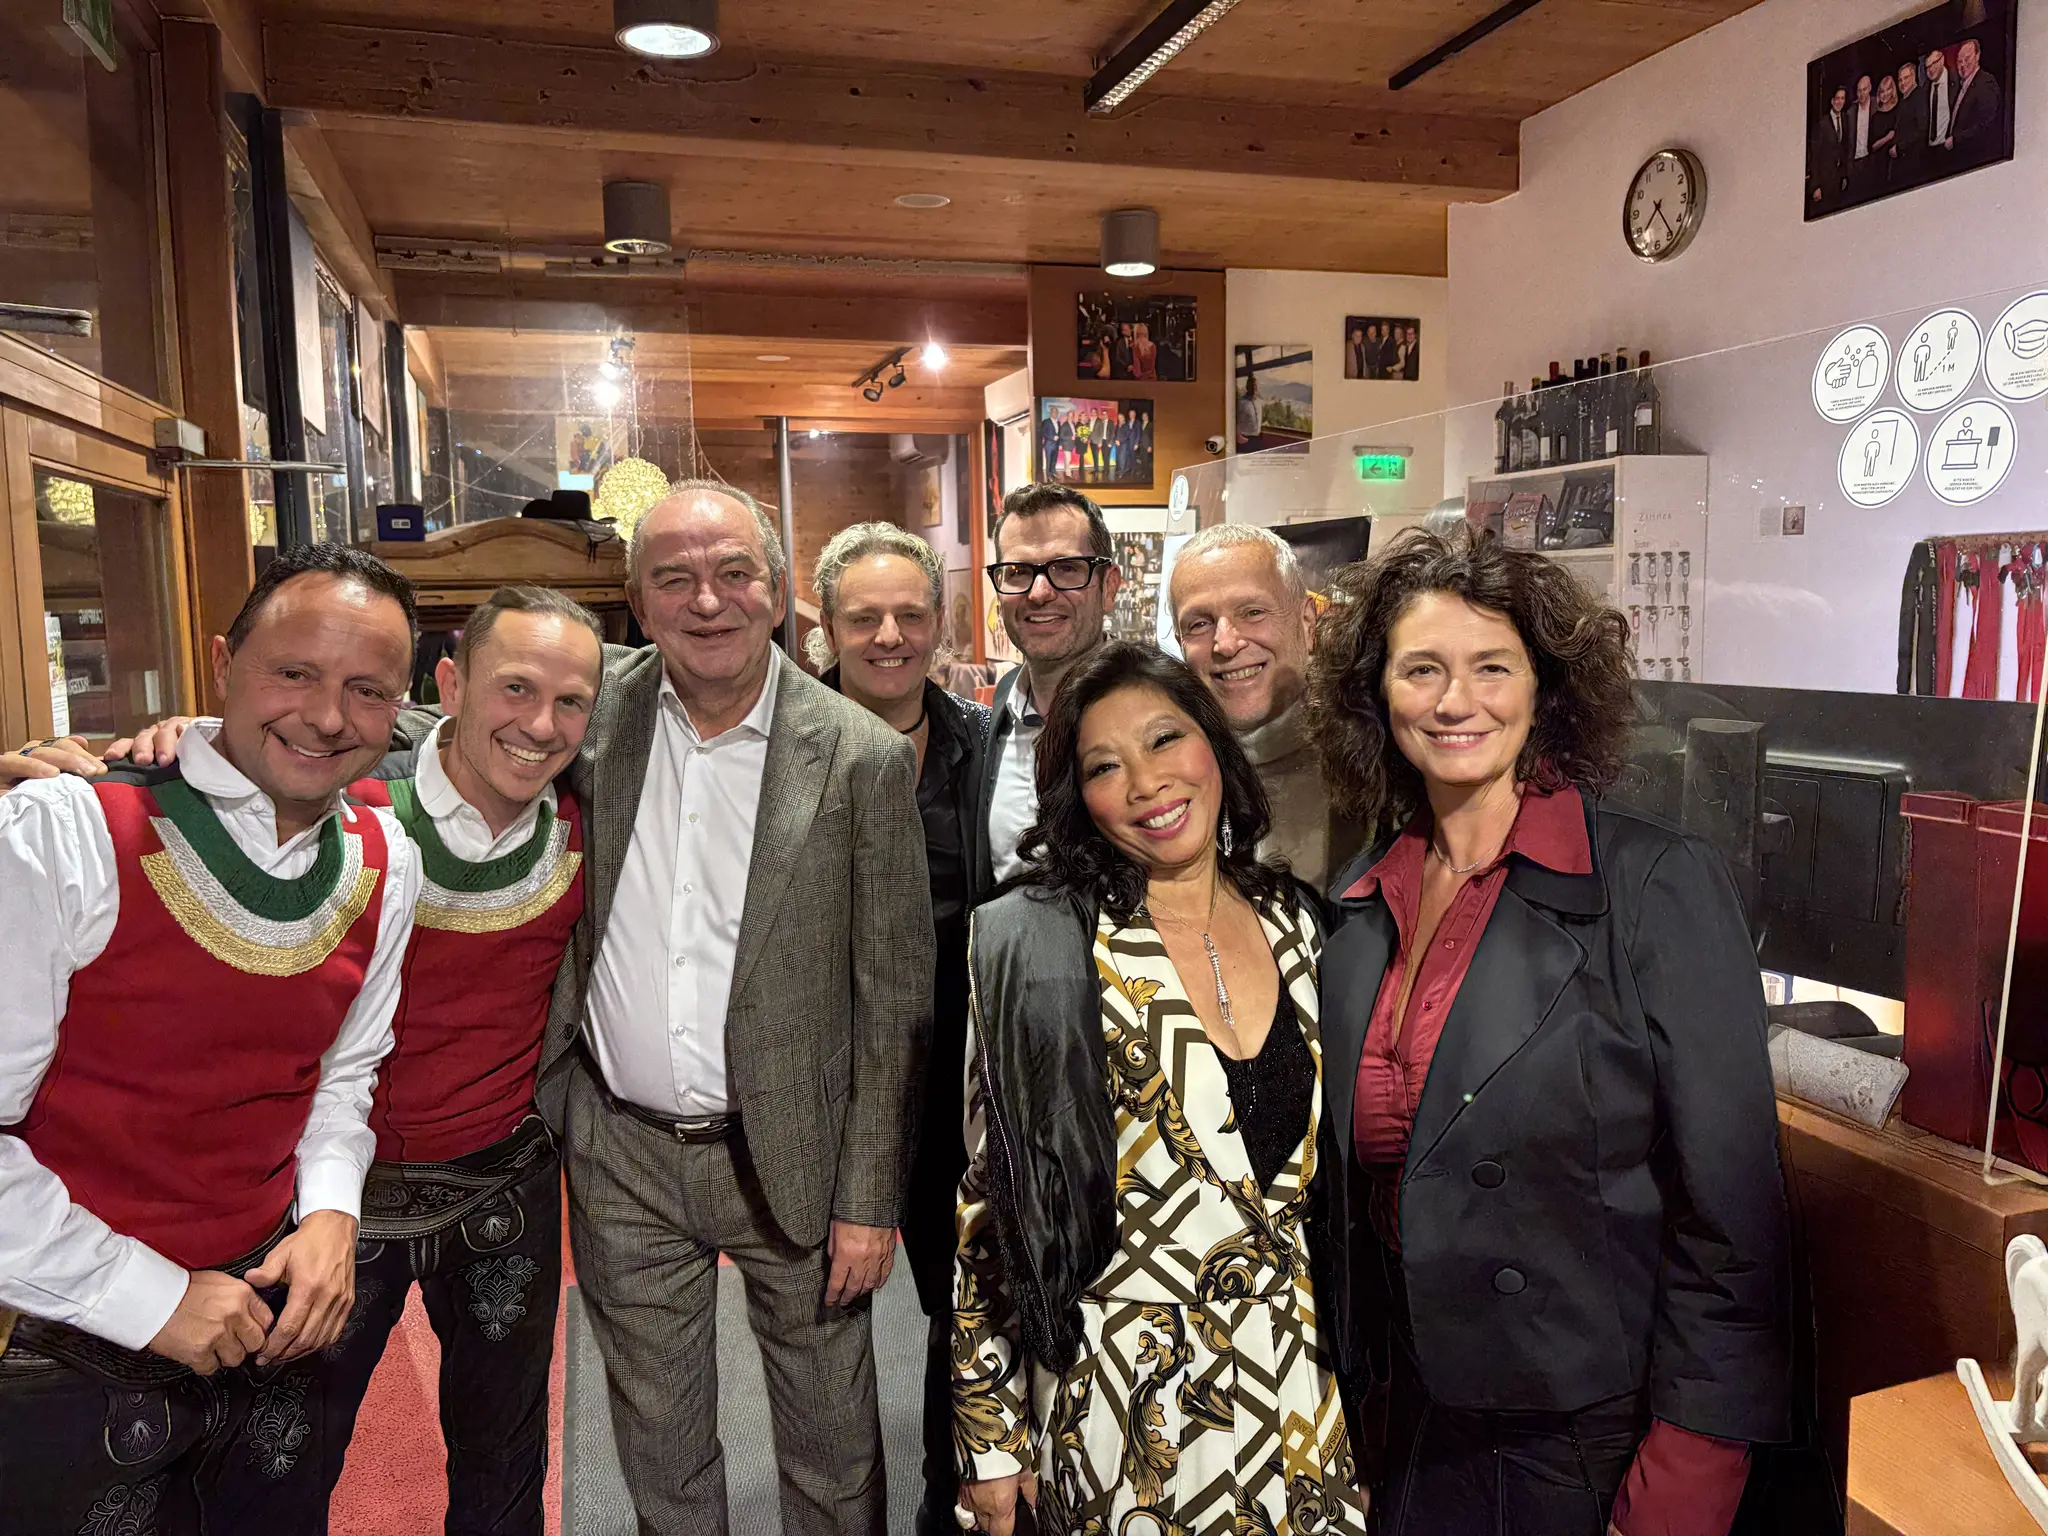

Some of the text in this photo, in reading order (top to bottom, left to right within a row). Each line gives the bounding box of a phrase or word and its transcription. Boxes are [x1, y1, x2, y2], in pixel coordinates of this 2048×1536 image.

[1656, 161, 1665, 173] 12
[1645, 172, 1651, 184] 11
[1677, 173, 1684, 185] 2
[1637, 189, 1644, 200] 10
[1680, 193, 1687, 204] 3
[1632, 210, 1640, 220] 9
[1676, 212, 1682, 223] 4
[1666, 231, 1674, 242] 5
[1654, 240, 1662, 251] 6
[1948, 363, 1955, 372] M
